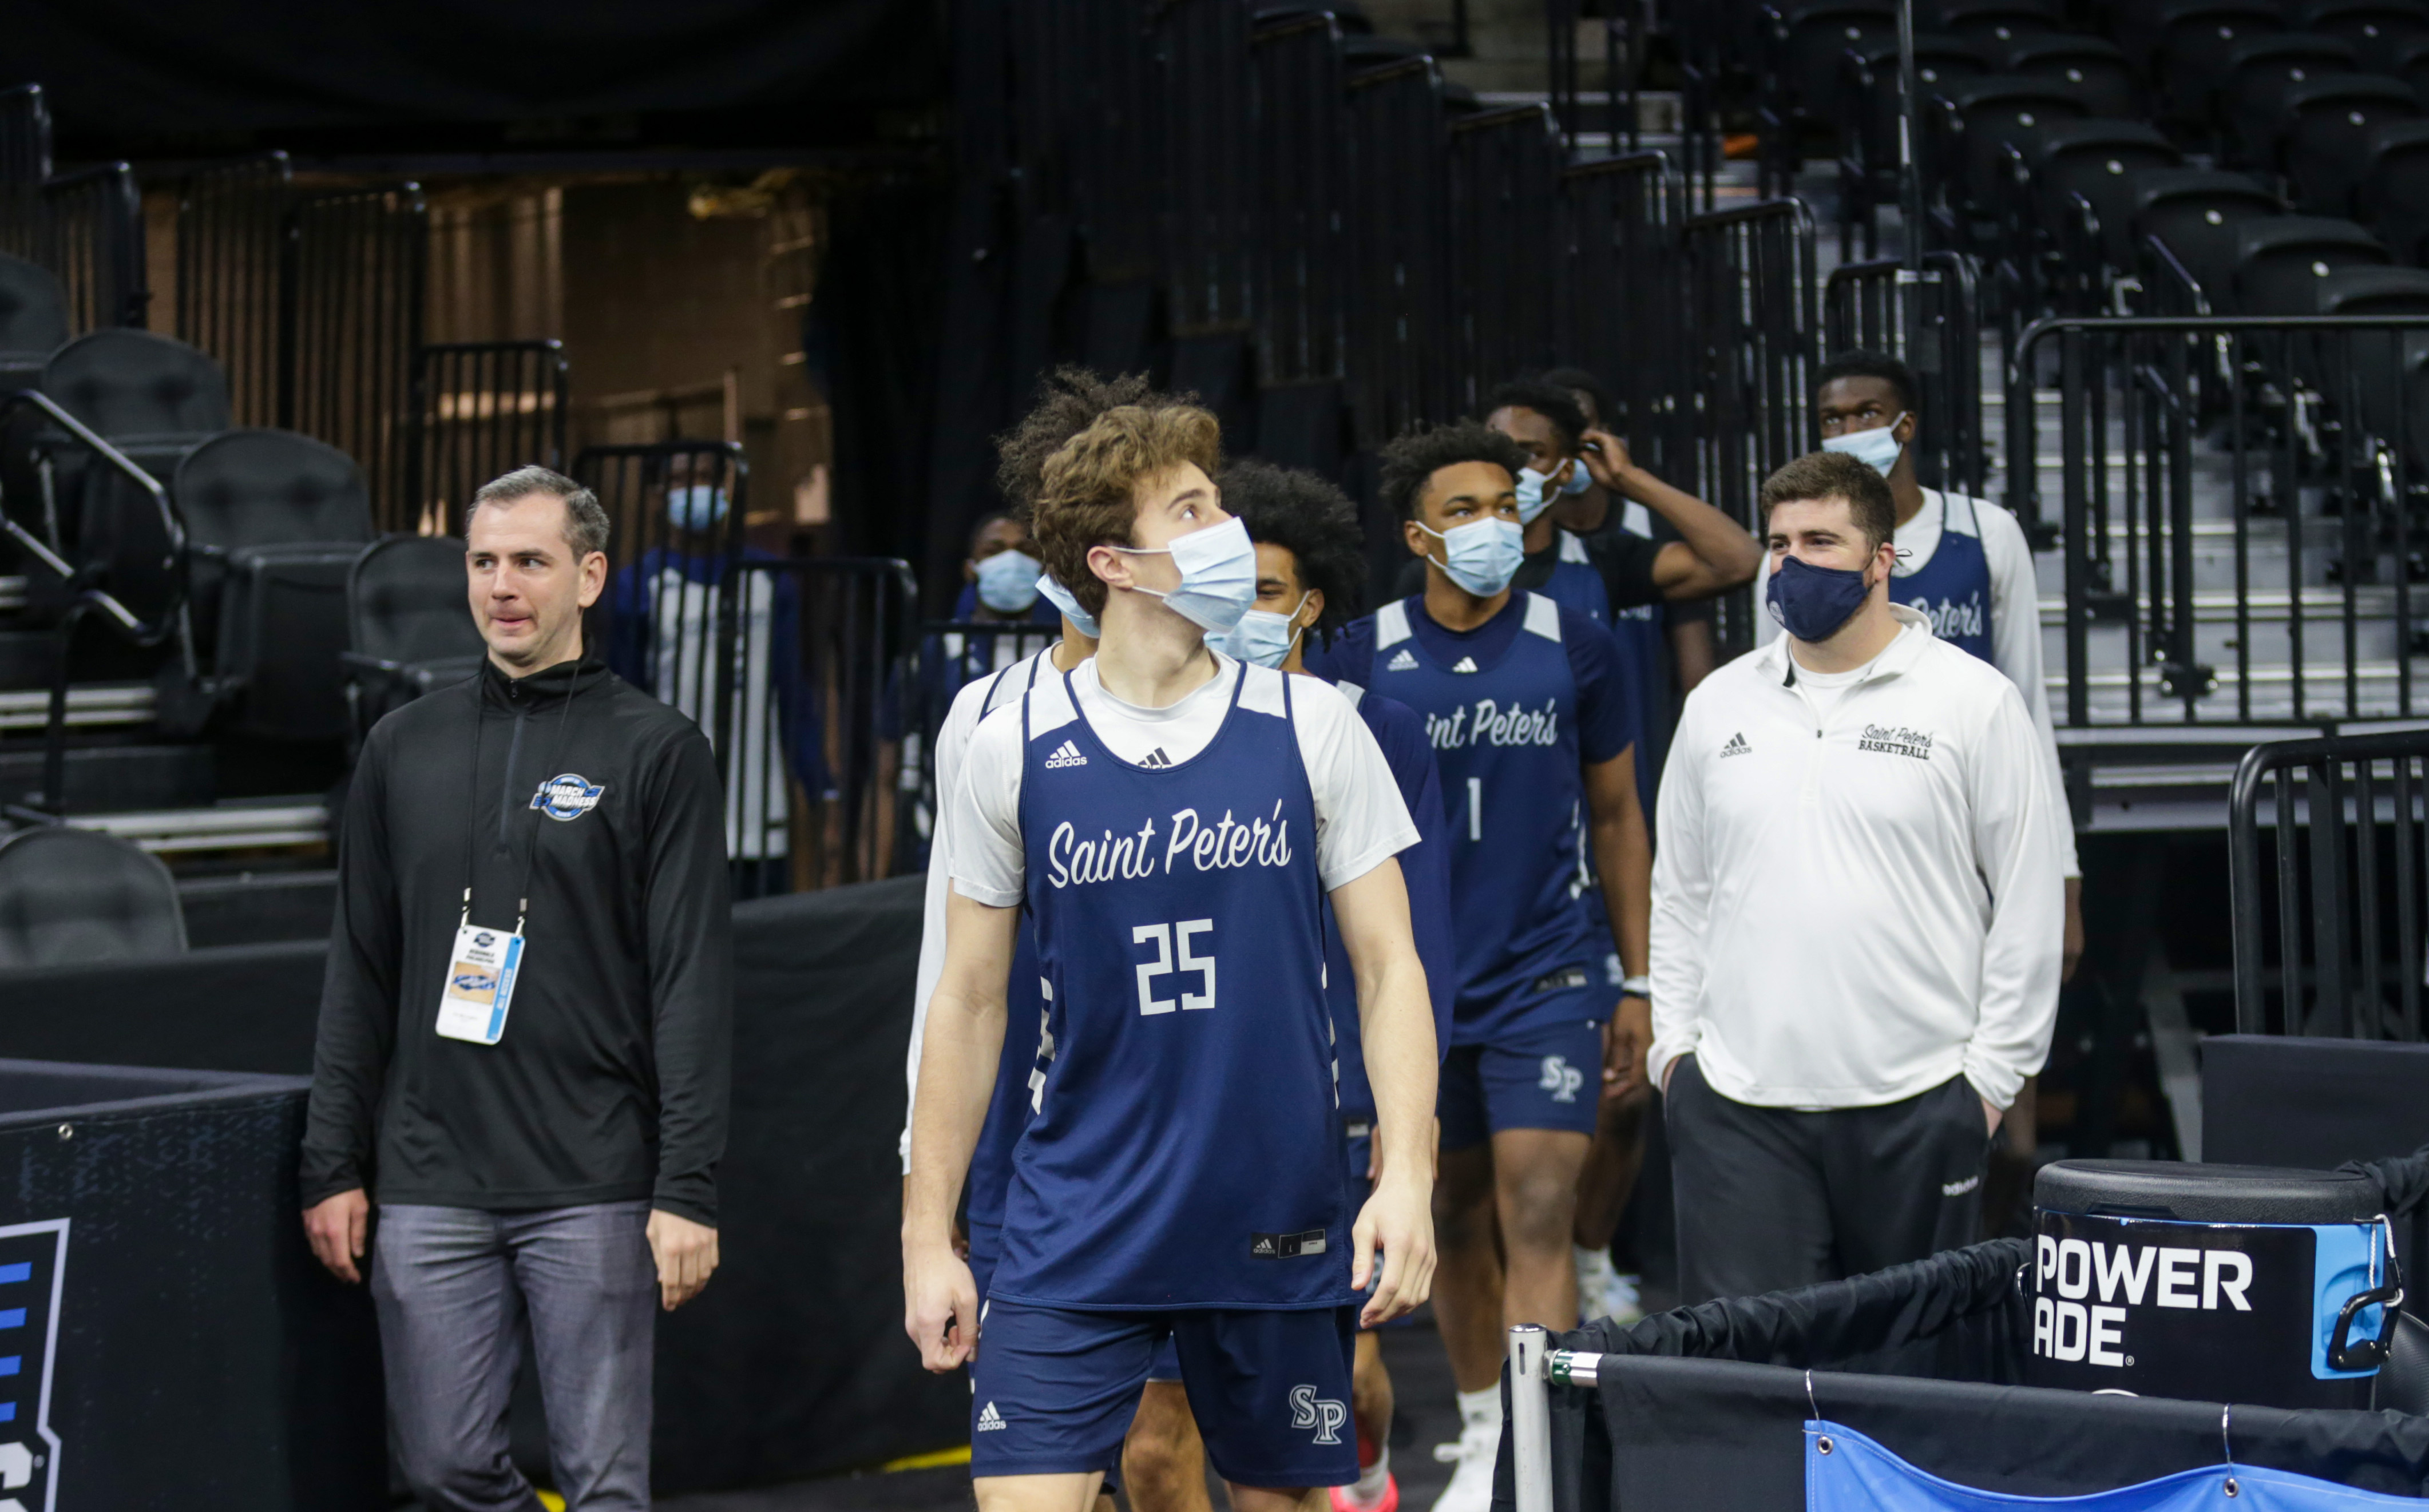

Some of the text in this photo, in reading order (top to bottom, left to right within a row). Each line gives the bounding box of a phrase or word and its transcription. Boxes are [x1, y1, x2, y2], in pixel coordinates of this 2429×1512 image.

[1425, 697, 1558, 749] int Peter's
[1861, 724, 1933, 748] Saint Peter's
[1045, 755, 1088, 769] adidas
[1720, 746, 1752, 759] adidas
[1858, 739, 1929, 760] BASKETBALL
[549, 784, 586, 797] MARCH
[550, 795, 599, 809] MADNESS
[1467, 777, 1481, 841] 1
[1048, 798, 1291, 888] Saint Peter's
[1132, 918, 1215, 1015] 25
[1539, 1054, 1584, 1103] SP
[2036, 1234, 2253, 1311] POWER
[2034, 1296, 2126, 1367] ADE
[977, 1419, 1007, 1432] adidas
[1289, 1384, 1347, 1445] SP
